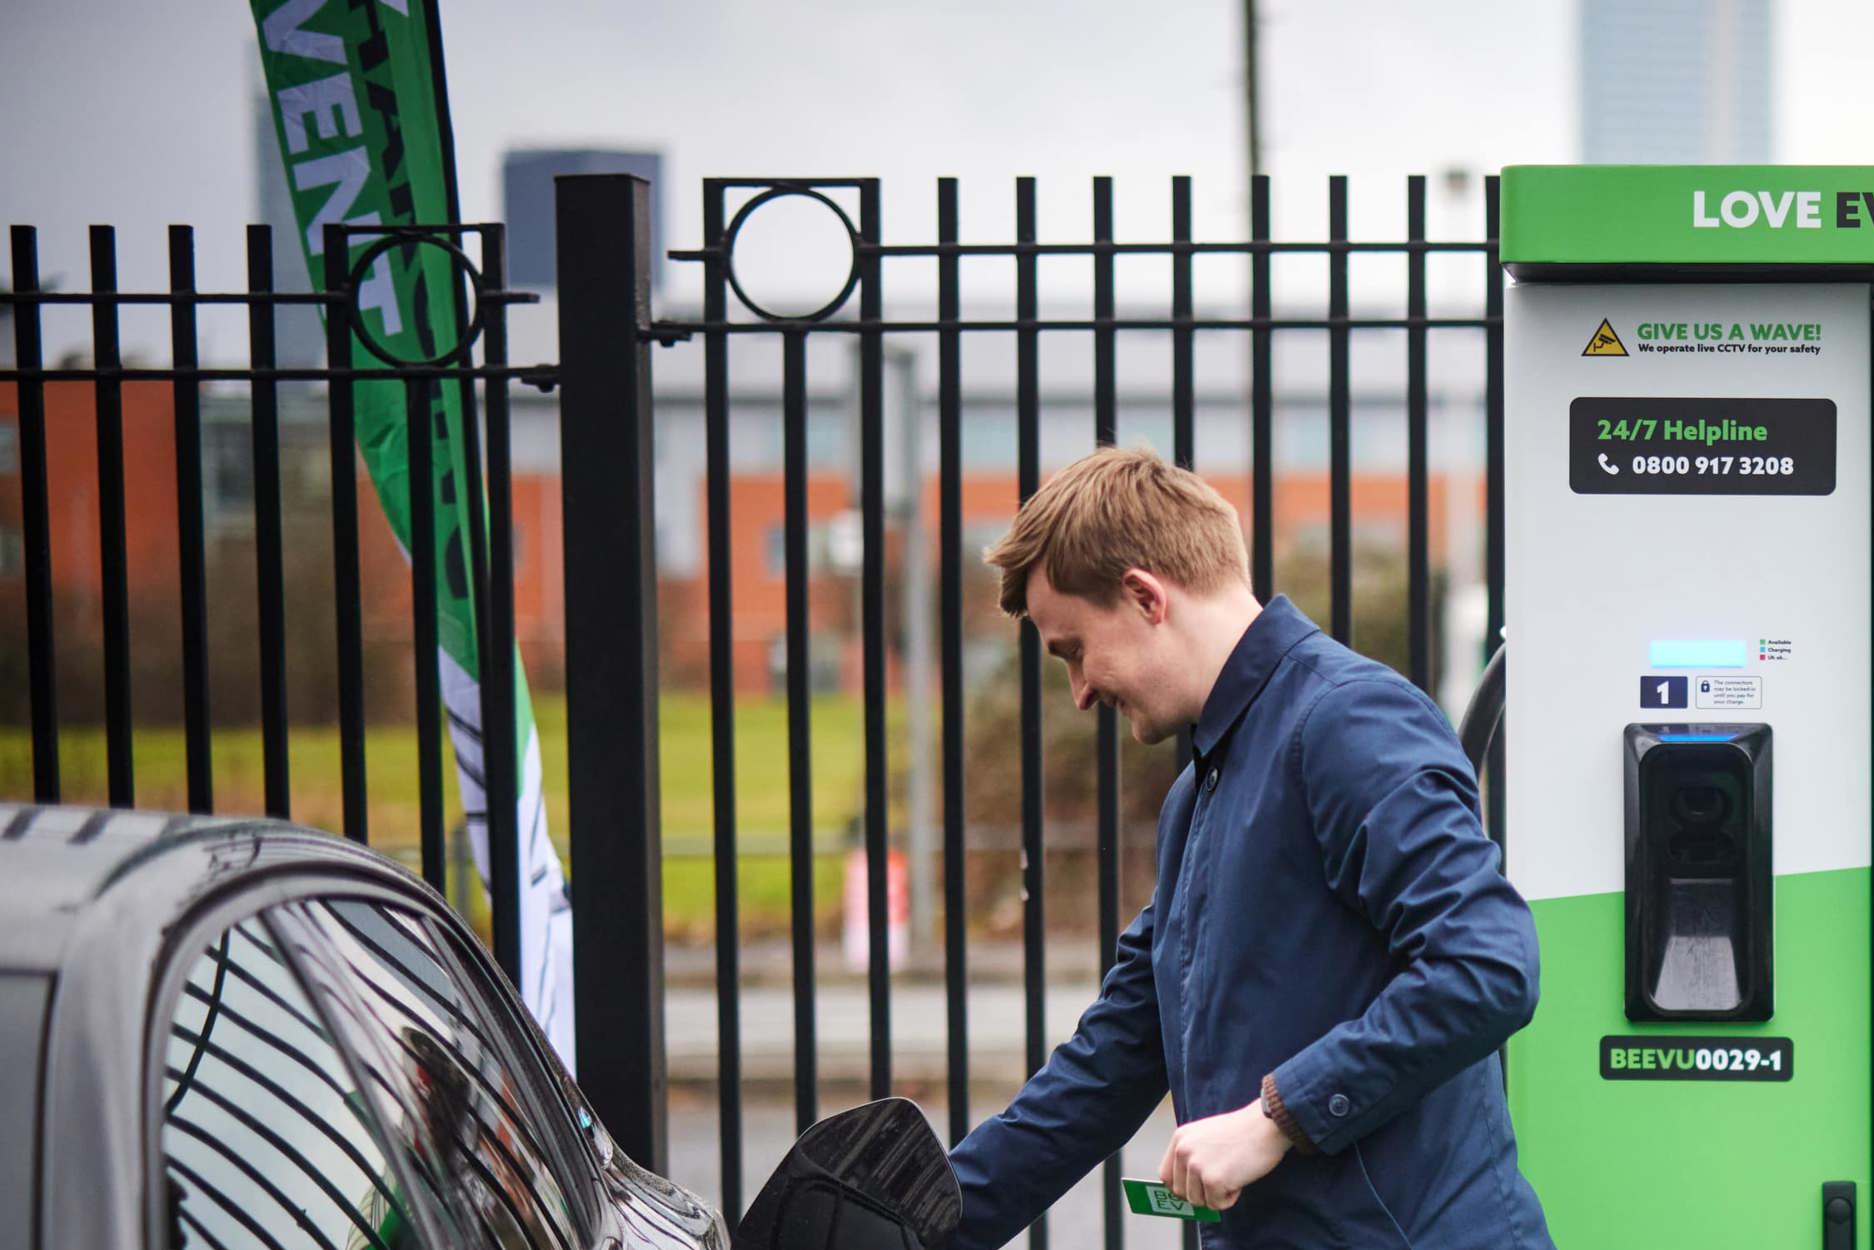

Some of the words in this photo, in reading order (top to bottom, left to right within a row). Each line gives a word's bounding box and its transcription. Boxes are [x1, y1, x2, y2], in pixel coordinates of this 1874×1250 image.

[1693, 191, 1822, 228] LOVE
[1636, 323, 1689, 341] GIVE
[1694, 323, 1723, 341] US
[1729, 323, 1745, 341] A
[1750, 323, 1822, 341] WAVE!
[1638, 344, 1655, 353] We
[1656, 345, 1695, 355] operate
[1697, 343, 1715, 353] live
[1717, 344, 1745, 353] CCTV
[1747, 344, 1763, 353] for
[1764, 346, 1789, 355] your
[1789, 344, 1821, 355] safety
[1597, 419, 1657, 441] 24/7
[1663, 419, 1768, 446] Helpline
[1632, 456, 1690, 475] 0800
[1695, 456, 1734, 475] 917
[1739, 457, 1794, 475] 3208
[1657, 681, 1669, 704] 1
[1610, 1049, 1781, 1070] BEEVU0029-1
